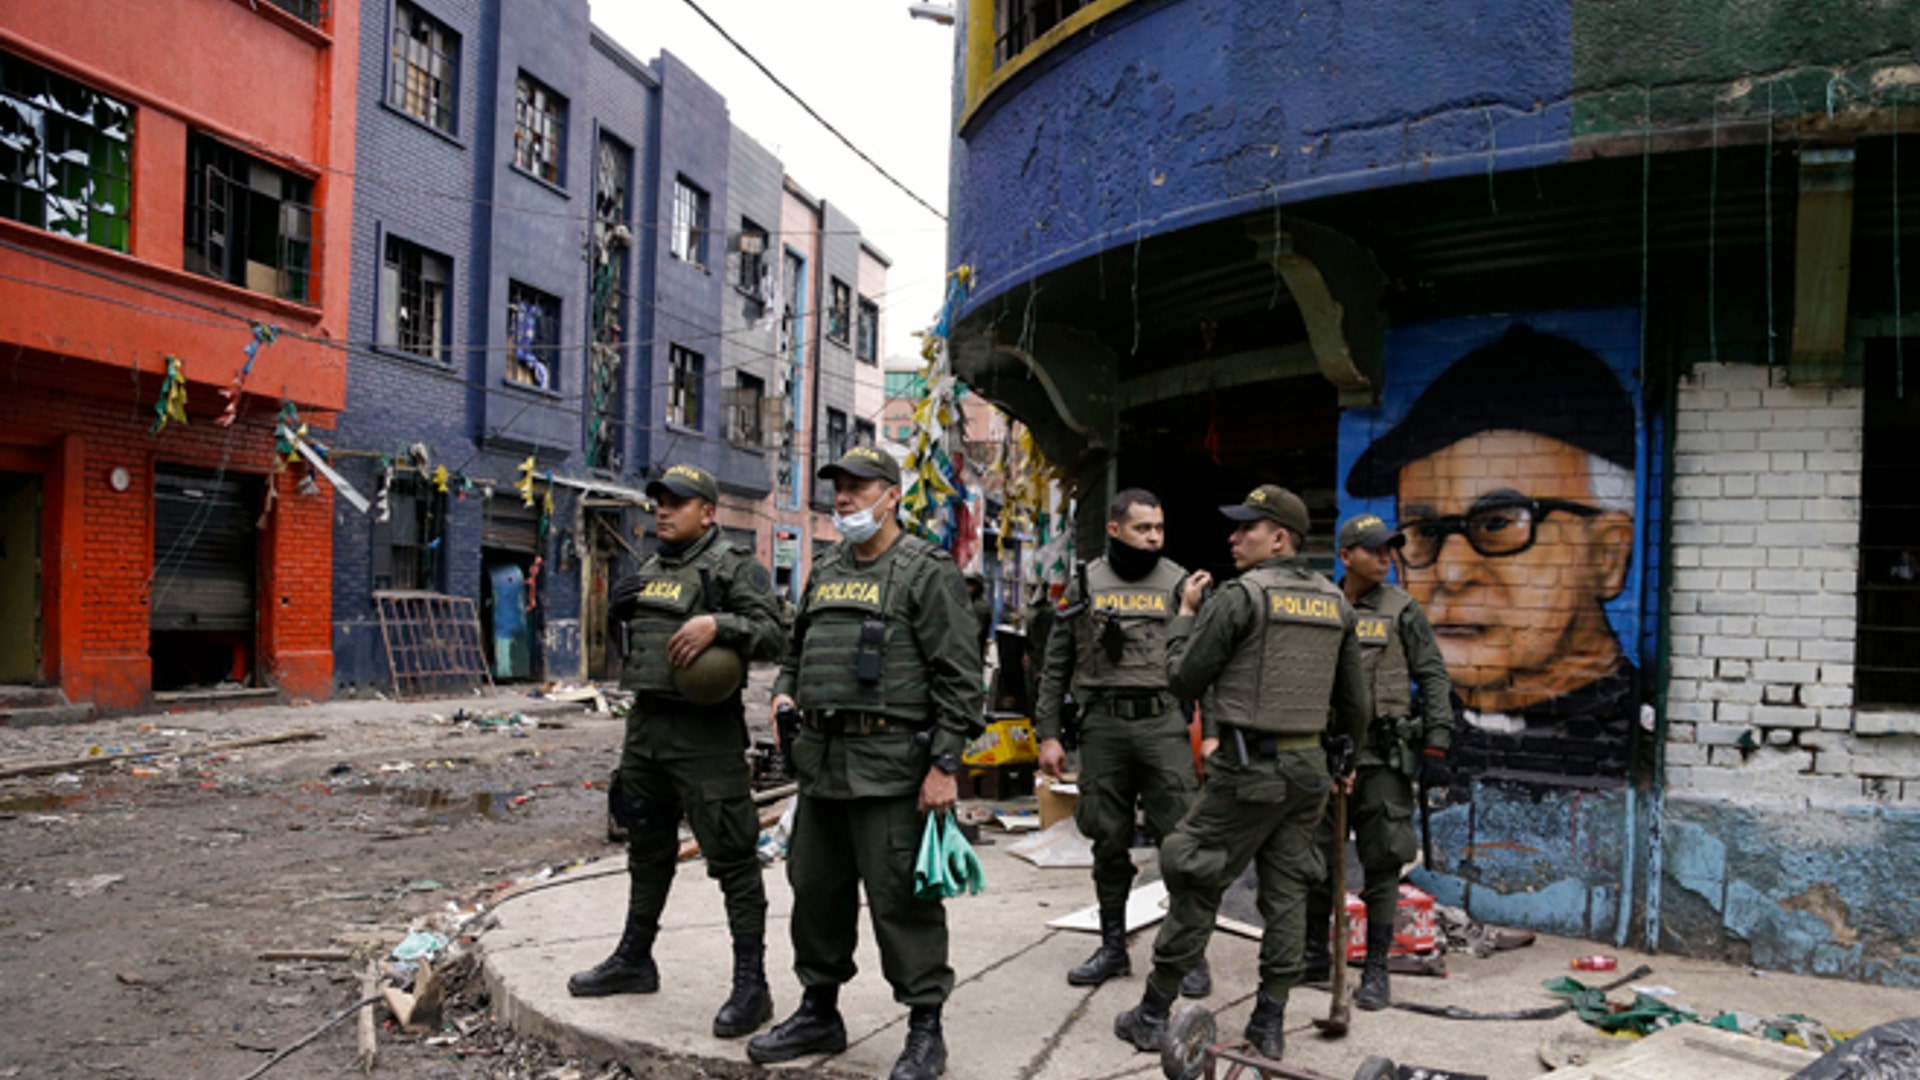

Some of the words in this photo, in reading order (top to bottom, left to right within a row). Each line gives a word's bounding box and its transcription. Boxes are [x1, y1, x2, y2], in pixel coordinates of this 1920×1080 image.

[638, 580, 682, 601] LICIA
[815, 582, 880, 605] POLICIA
[1095, 593, 1165, 612] POLICIA
[1271, 595, 1340, 619] POLICIA
